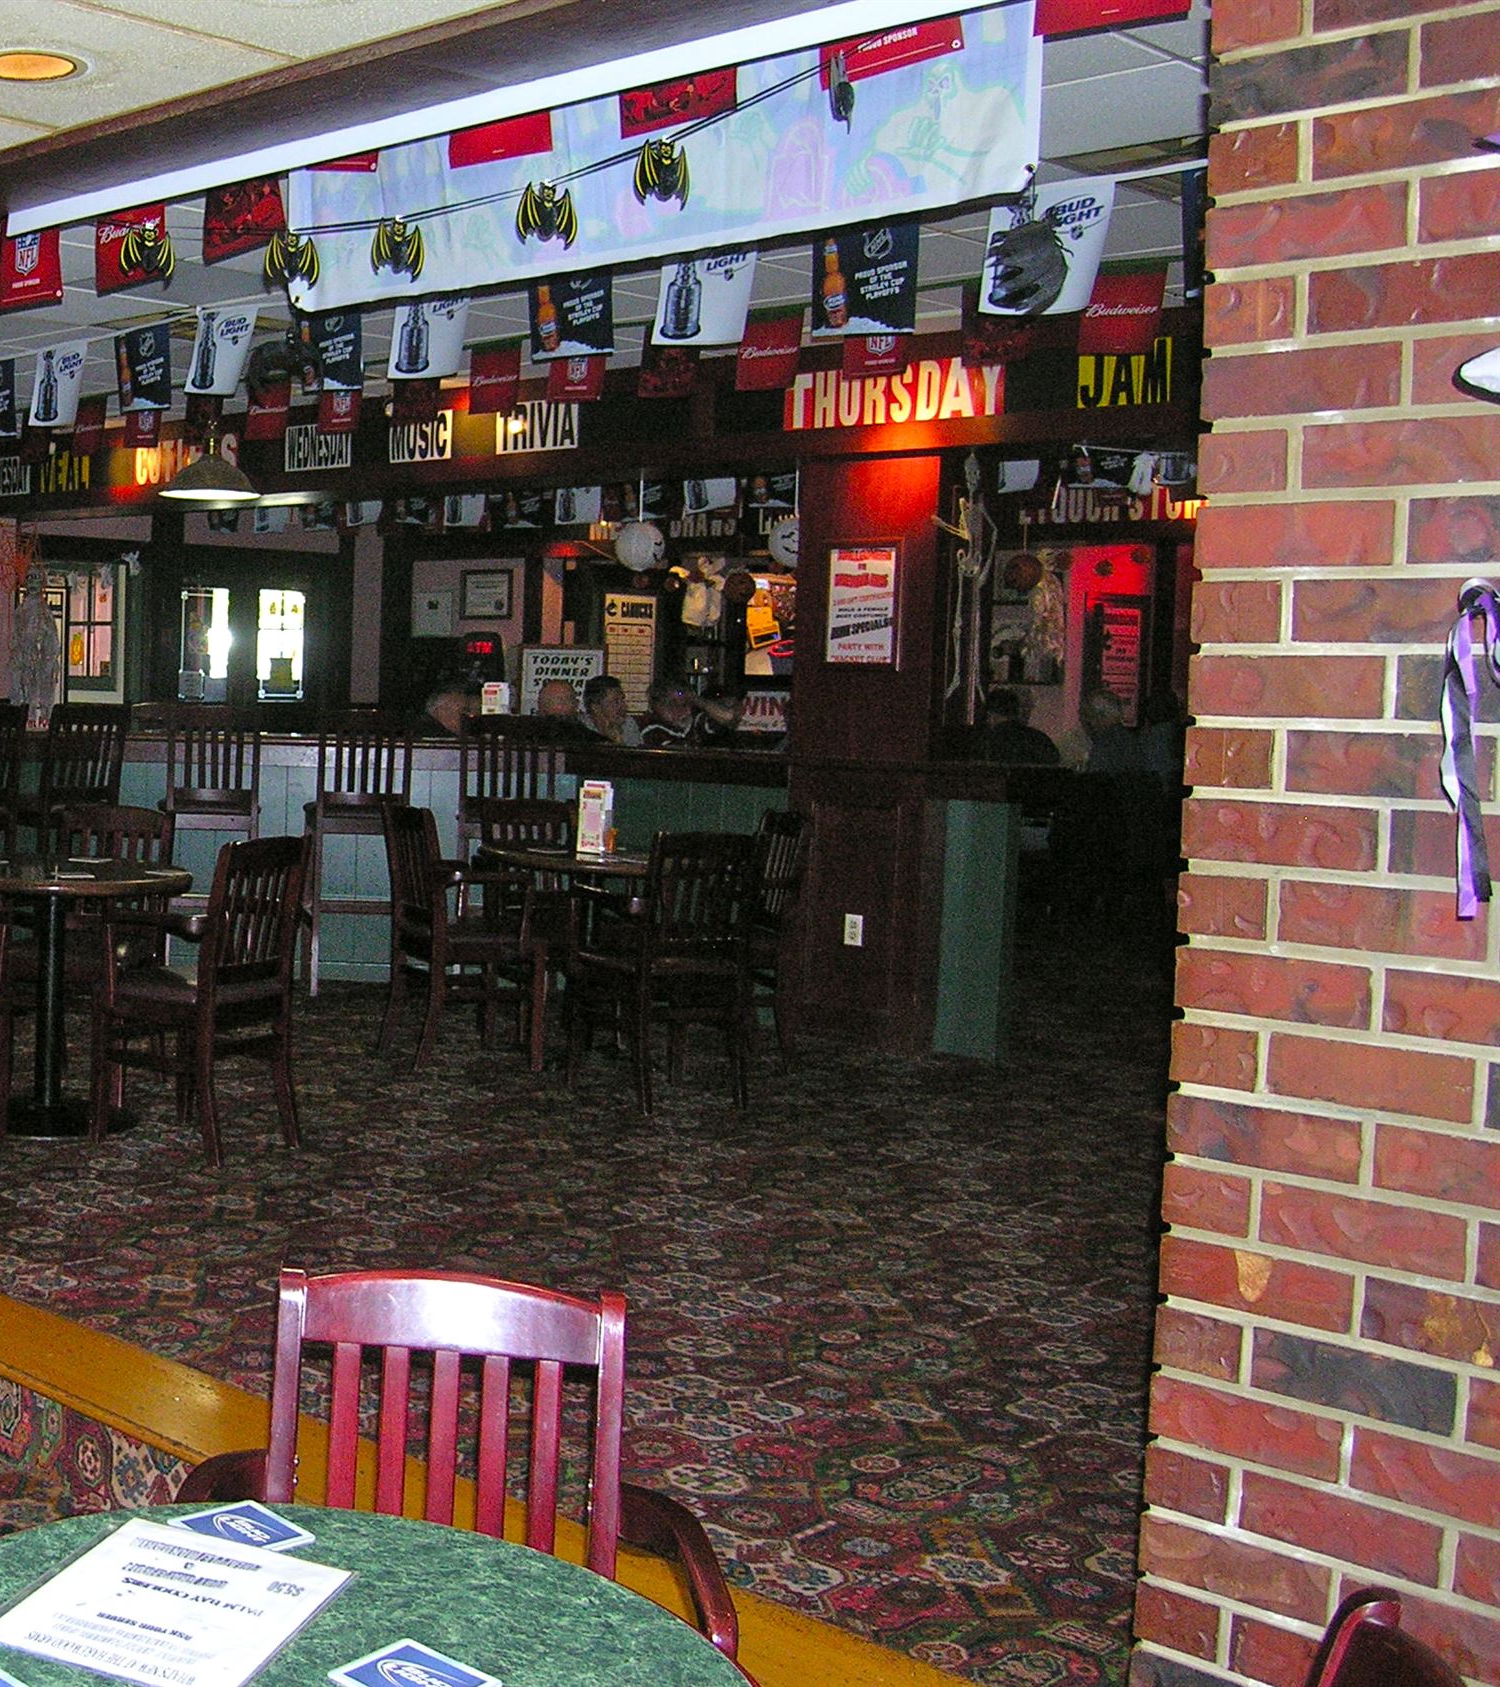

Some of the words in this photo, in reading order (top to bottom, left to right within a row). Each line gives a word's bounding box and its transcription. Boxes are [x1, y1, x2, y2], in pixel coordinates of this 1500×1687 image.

[883, 26, 919, 46] SPONSOR
[1055, 196, 1097, 214] BUD
[1056, 205, 1104, 227] GHT
[706, 252, 749, 273] LIGHT
[431, 297, 465, 314] LIGHT
[1085, 302, 1158, 318] Budweiser
[219, 324, 250, 338] LIGHT
[223, 316, 248, 330] BUD
[61, 353, 80, 365] BUD
[740, 347, 798, 360] Budweiser
[59, 359, 84, 373] LIGHT
[1080, 338, 1168, 407] JAM
[793, 358, 1003, 429] THURSDAY
[500, 402, 575, 451] TRIVIA
[390, 413, 447, 460] MUSIC
[287, 426, 350, 470] WEDNESDAY
[136, 434, 237, 486] CUTLS
[531, 655, 594, 666] TODAY'S
[534, 666, 590, 678] DINNER
[121, 1577, 190, 1599] COOLERS
[191, 1594, 221, 1607] BAY
[222, 1602, 264, 1617] PALM
[97, 1612, 138, 1626] SERVER
[138, 1623, 169, 1635] YOUR
[170, 1628, 193, 1641] ASK
